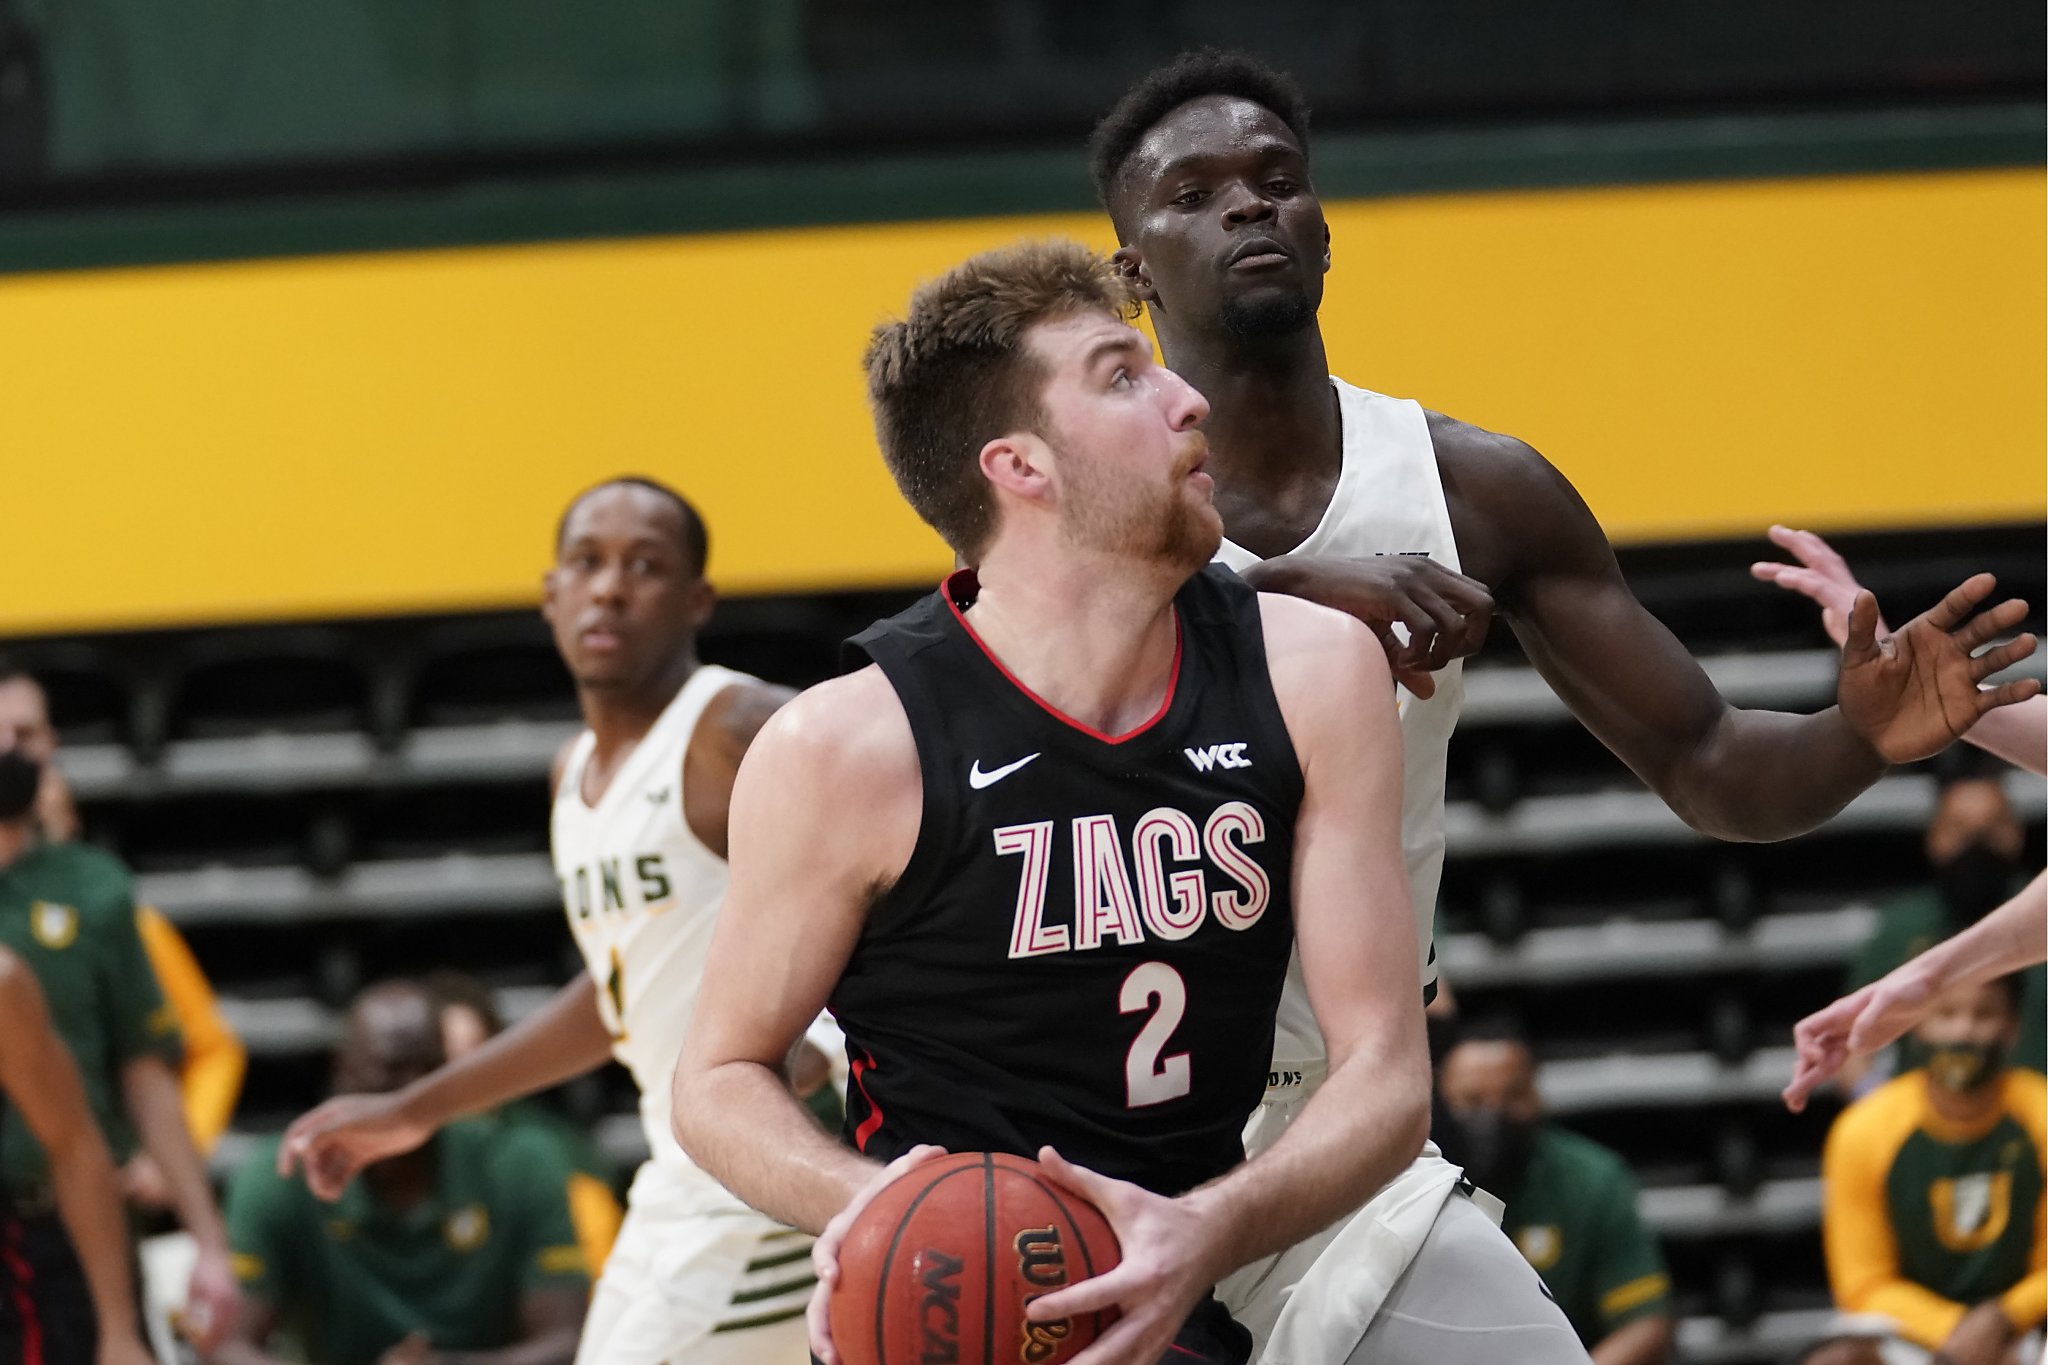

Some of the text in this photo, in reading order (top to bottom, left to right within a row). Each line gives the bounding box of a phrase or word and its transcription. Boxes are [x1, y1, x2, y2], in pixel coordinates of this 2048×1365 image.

[1183, 742, 1253, 773] WCC
[560, 854, 672, 920] ONS
[993, 801, 1271, 960] ZAGS
[1118, 960, 1192, 1109] 2
[1013, 1224, 1073, 1364] Wls
